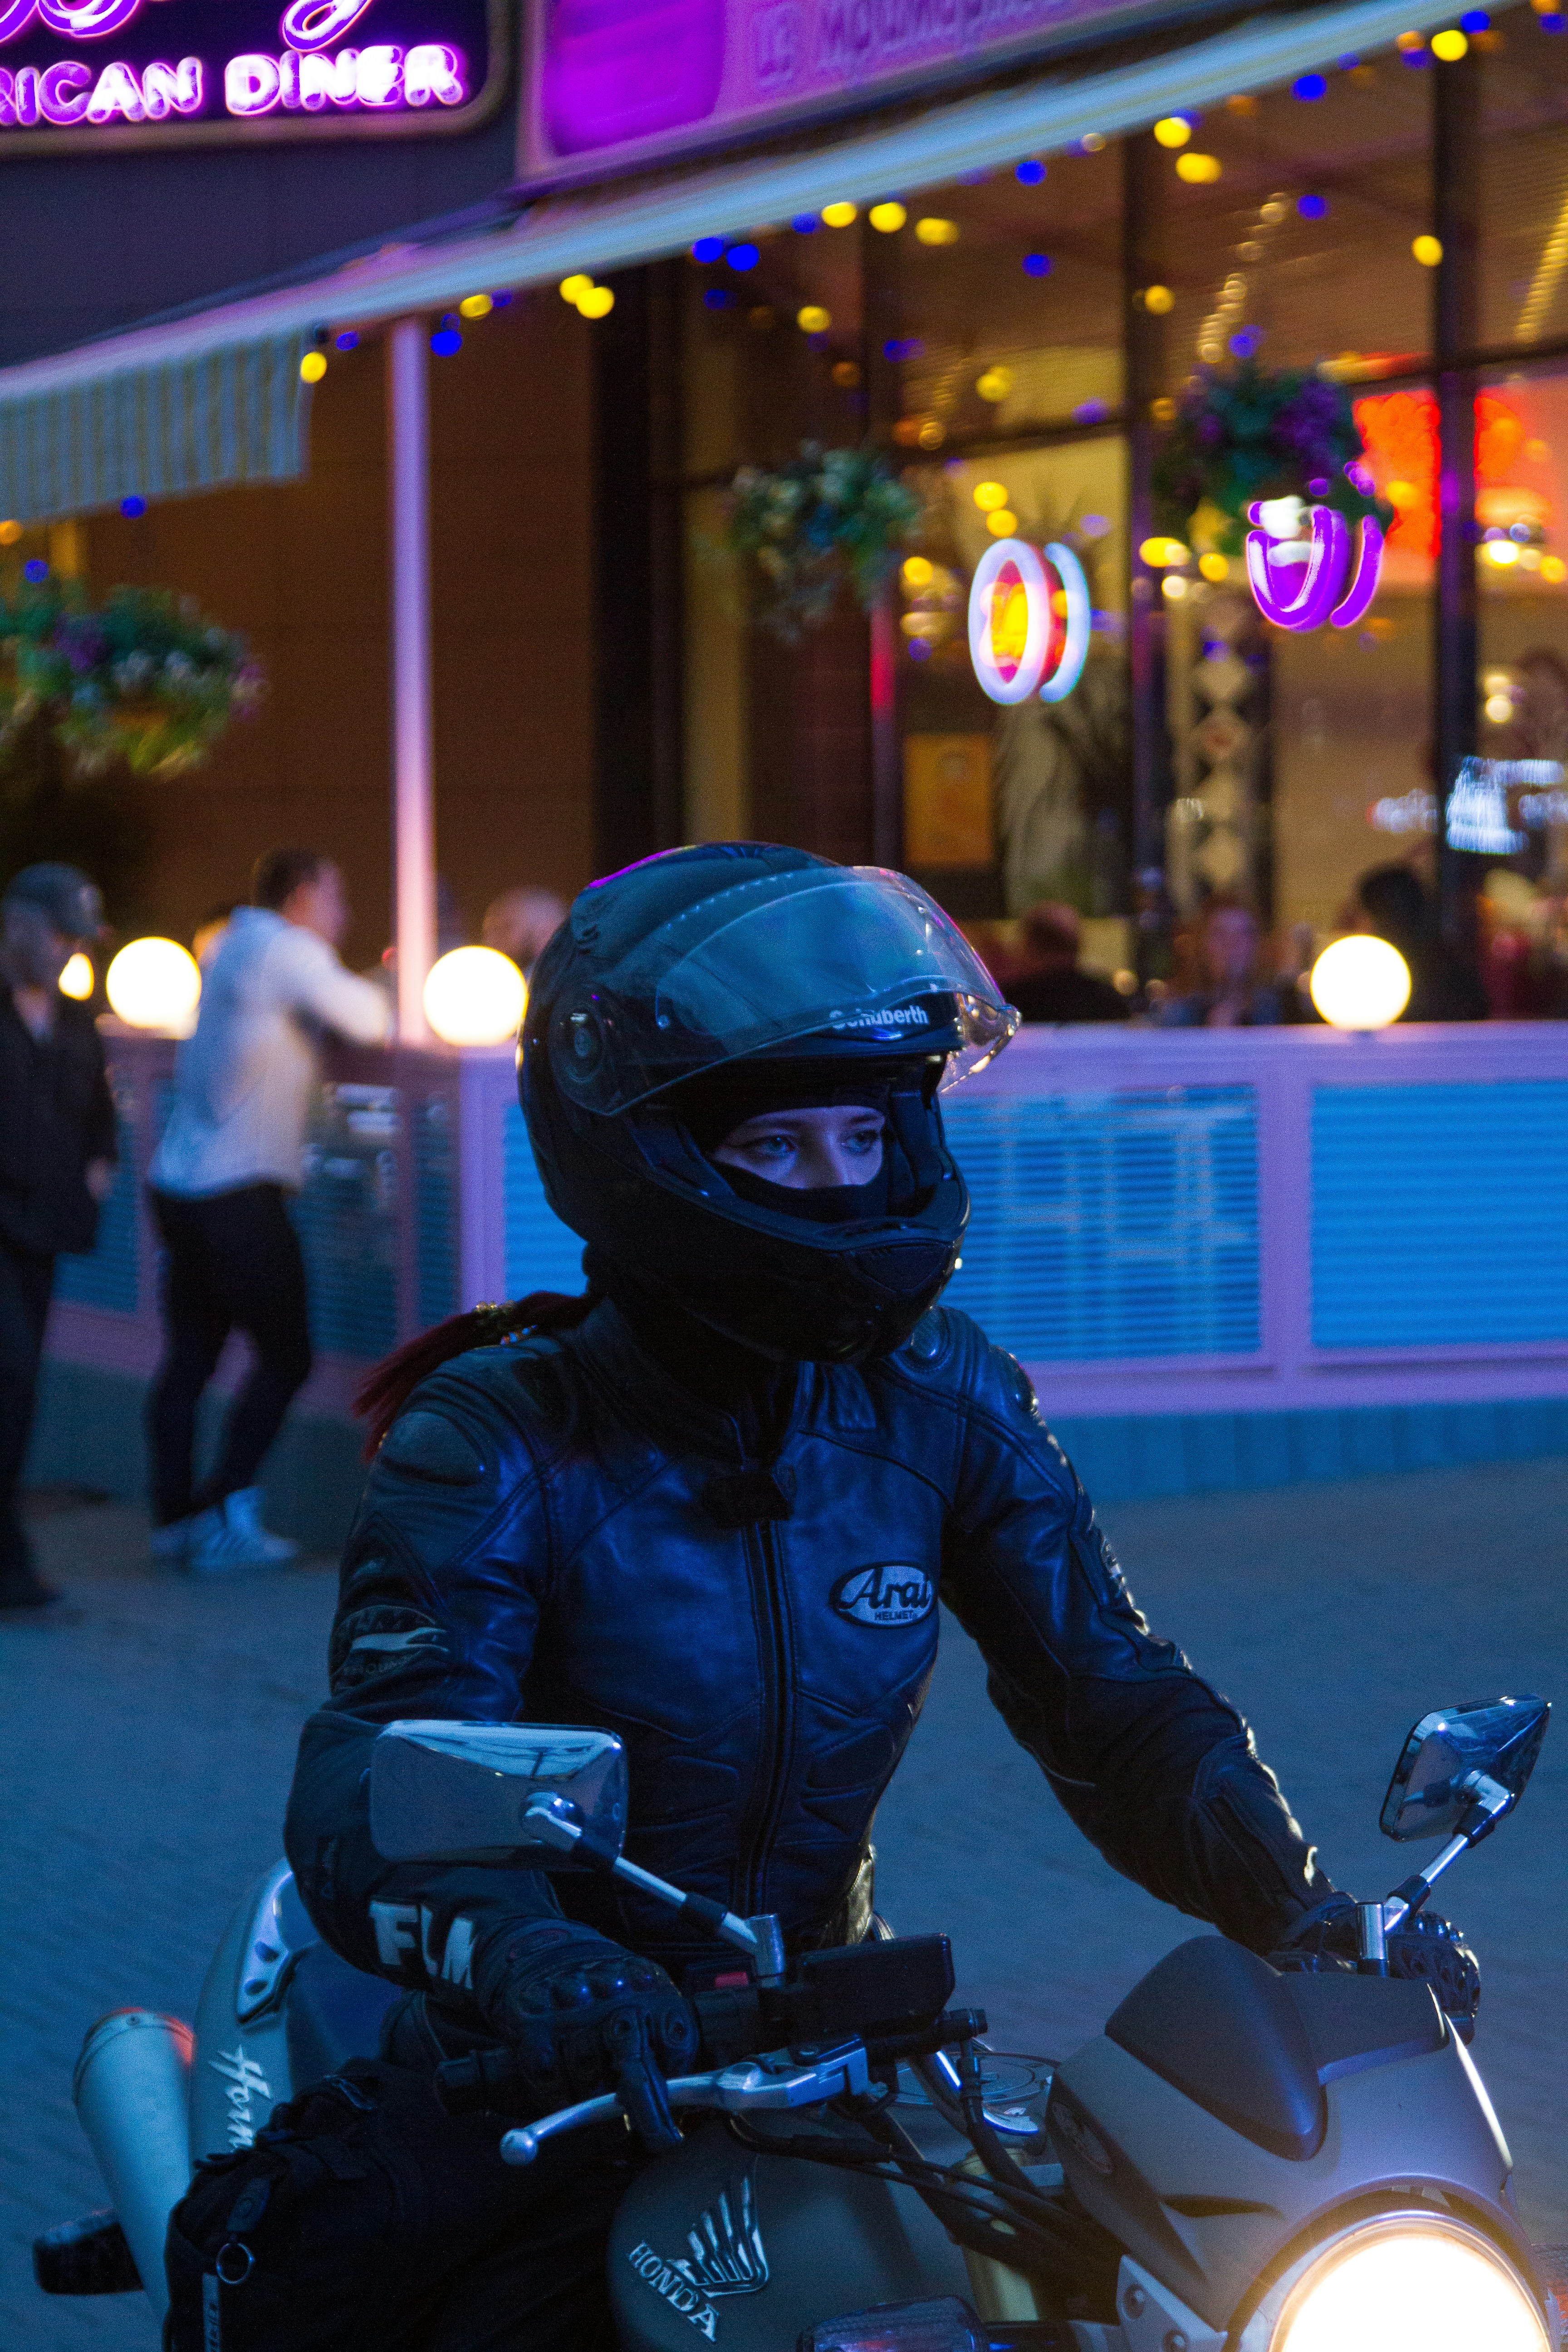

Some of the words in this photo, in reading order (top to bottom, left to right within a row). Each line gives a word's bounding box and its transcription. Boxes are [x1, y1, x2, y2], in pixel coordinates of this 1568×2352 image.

[0, 57, 202, 126] ICAN
[225, 44, 463, 115] DINER
[839, 1566, 931, 1610] Arai
[207, 2043, 272, 2153] Horn
[627, 2239, 720, 2342] HONDA
